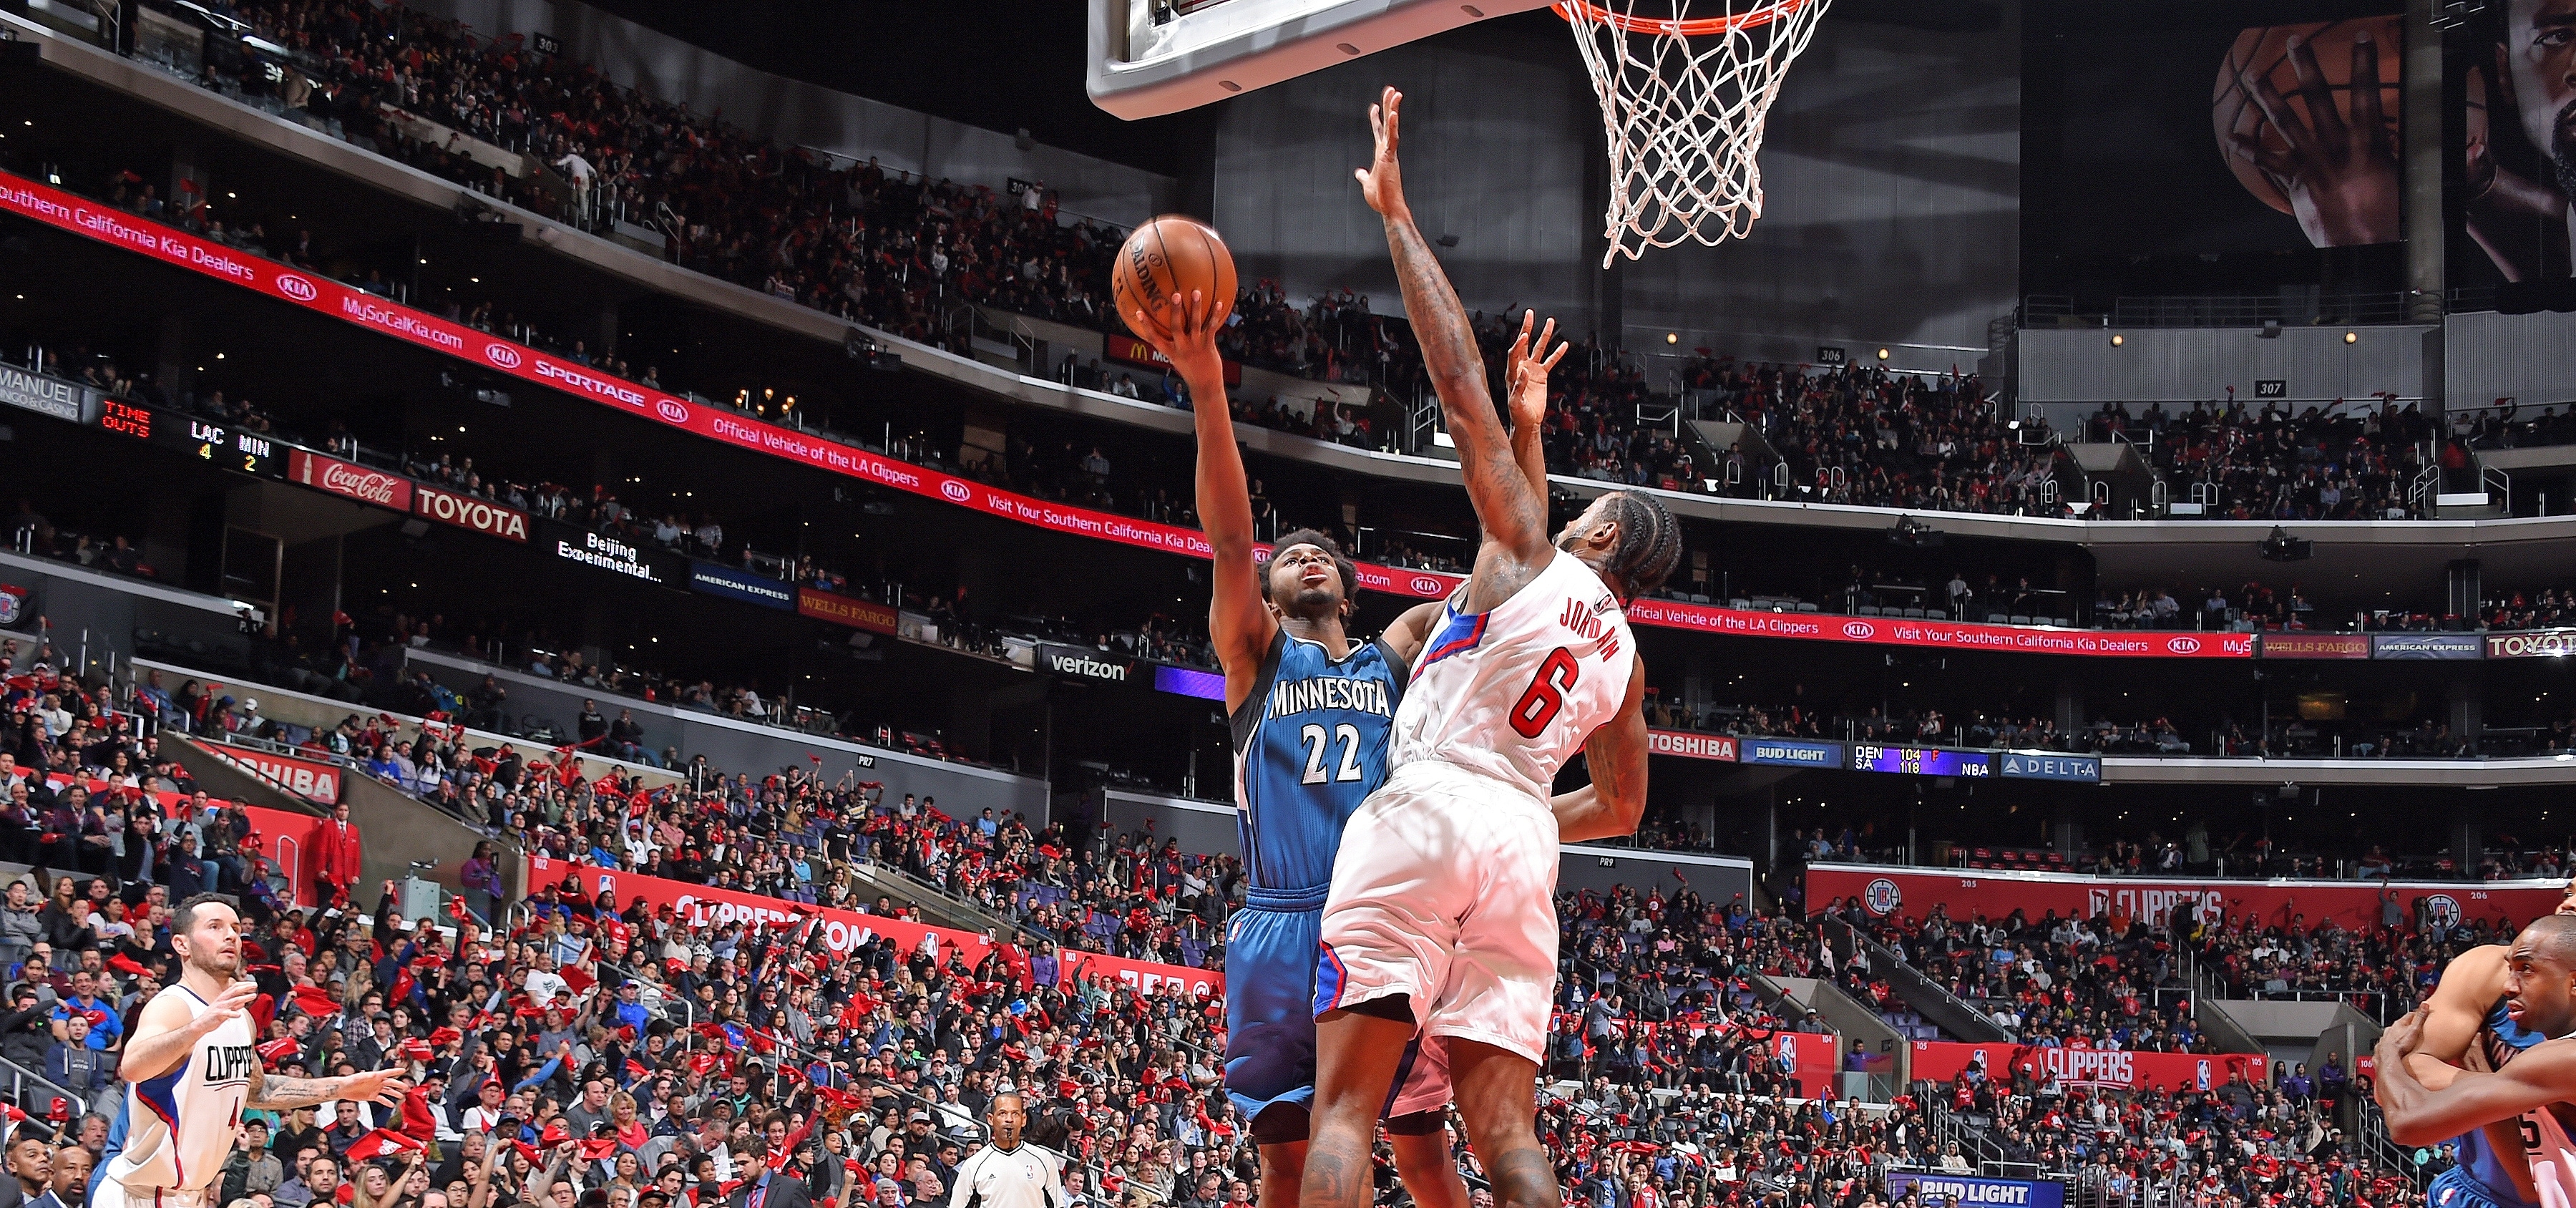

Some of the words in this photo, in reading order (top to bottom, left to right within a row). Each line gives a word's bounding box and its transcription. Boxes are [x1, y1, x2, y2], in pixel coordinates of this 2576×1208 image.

[538, 38, 558, 54] 303
[75, 208, 156, 249] California
[161, 235, 187, 259] Kia
[192, 246, 254, 281] Dealers
[343, 296, 464, 349] MySoCalKia.com
[1822, 350, 1840, 361] 306
[535, 359, 645, 408] SPORTAGE
[2260, 383, 2282, 394] 307
[104, 400, 151, 424] TIME
[102, 417, 150, 438] OUTS
[191, 421, 224, 444] LAC
[239, 434, 270, 458] MIN
[199, 443, 212, 459] 4
[245, 455, 256, 472] 2
[713, 419, 760, 444] Official
[763, 432, 808, 457] Vehicle
[811, 446, 826, 461] of
[828, 451, 849, 468] the
[852, 457, 869, 474] LA
[872, 462, 919, 488] Clippers
[323, 463, 398, 504] Coca-Cola
[419, 489, 527, 540] TOYOTA
[987, 492, 1013, 514] Visit
[1015, 502, 1041, 520] Your
[1043, 509, 1102, 533] Southern
[1105, 521, 1163, 545] California
[1165, 532, 1184, 548] Kia
[587, 532, 637, 562] Beijing
[694, 573, 746, 591] AMERICAN
[748, 585, 789, 600] EXPRESS
[801, 595, 848, 617] WELLS
[852, 607, 895, 627] FARGO
[1667, 609, 1707, 625] Vehicle
[1709, 615, 1723, 626] of
[1725, 615, 1746, 630] the
[1750, 618, 1766, 630] LA
[1770, 619, 1819, 635] Clippers
[1559, 596, 1620, 663] JORDAN
[1893, 625, 1921, 640] Visit
[1925, 628, 1953, 643] Your
[1956, 630, 2013, 646] Southern
[2016, 634, 2074, 649] California
[2077, 638, 2097, 651] Kia
[2099, 639, 2148, 652] Dealers
[2265, 642, 2314, 653] WELLS
[2318, 642, 2366, 653] FARGO
[1050, 654, 1125, 681] verizon
[1268, 677, 1394, 723] MINNESOTA
[1509, 646, 1579, 739] 6
[1299, 722, 1363, 786] 22
[1647, 733, 1734, 758] TOSHIBA
[1756, 746, 1785, 759] BUD
[1786, 749, 1825, 761] LIGHT
[1855, 746, 1883, 759] DEN
[1900, 748, 1921, 761] 104
[1931, 749, 1939, 761] F
[859, 755, 874, 767] PR7
[1855, 758, 1874, 770] SA
[1900, 761, 1921, 774] 118
[1961, 762, 1989, 776] NBA
[2027, 759, 2097, 777] DELTA
[535, 858, 549, 871] 102
[1599, 857, 1614, 867] PR9
[1961, 880, 1976, 888] 205
[2116, 889, 2222, 926] CLIPPRS
[977, 935, 990, 945] 102
[1065, 952, 1077, 963] 103
[1821, 1035, 1833, 1044] 104
[1916, 1041, 1928, 1050] 105
[2047, 1048, 2133, 1083] CLIPPERS
[1968, 1182, 2029, 1204] LIGHT
